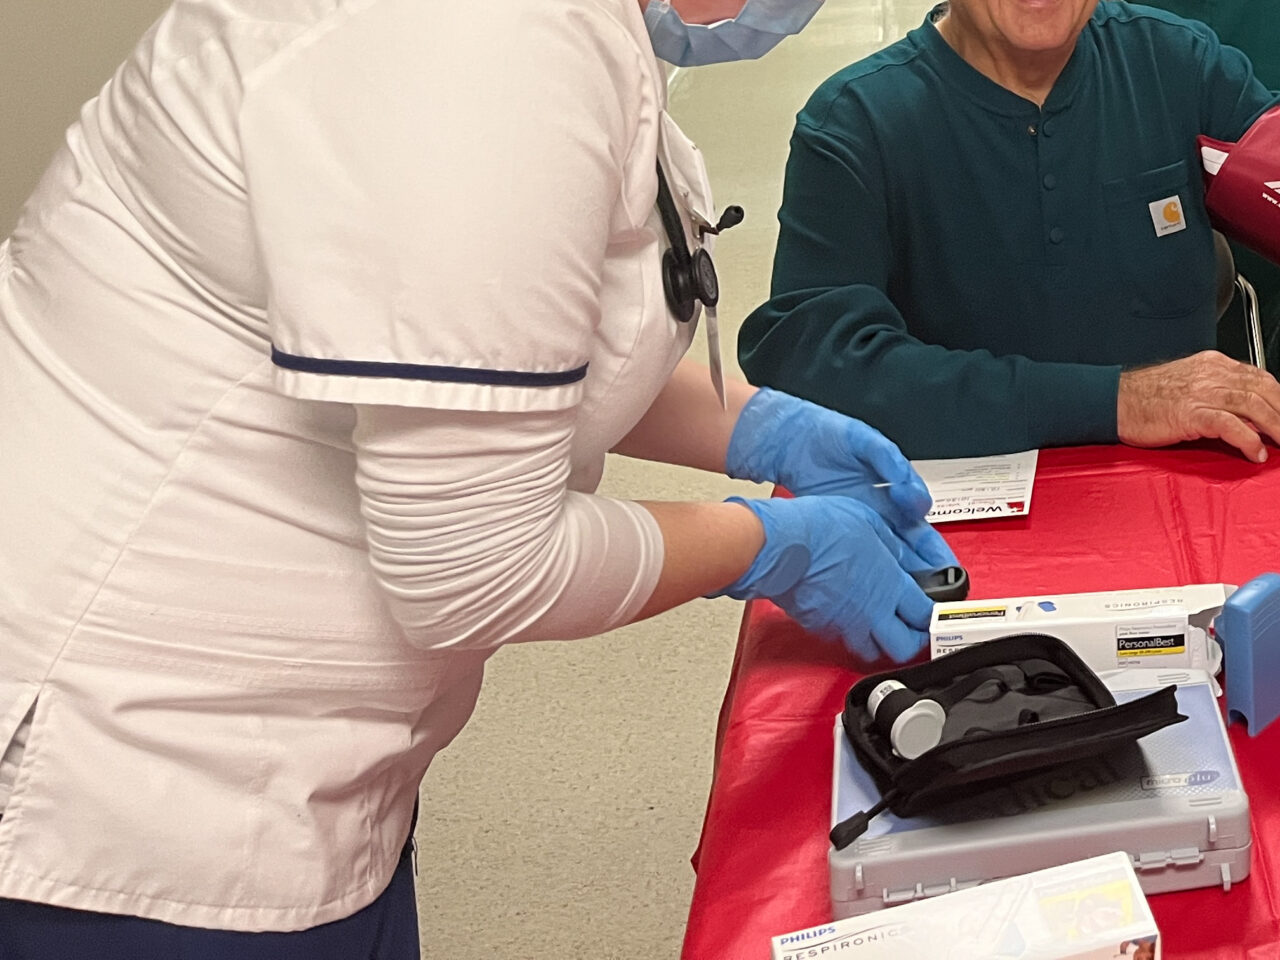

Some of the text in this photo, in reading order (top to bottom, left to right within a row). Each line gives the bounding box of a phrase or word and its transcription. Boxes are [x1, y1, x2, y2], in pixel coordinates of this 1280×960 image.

[927, 505, 1003, 517] Welcome
[1118, 637, 1175, 649] PersonalBest
[780, 926, 836, 945] PHILIPS
